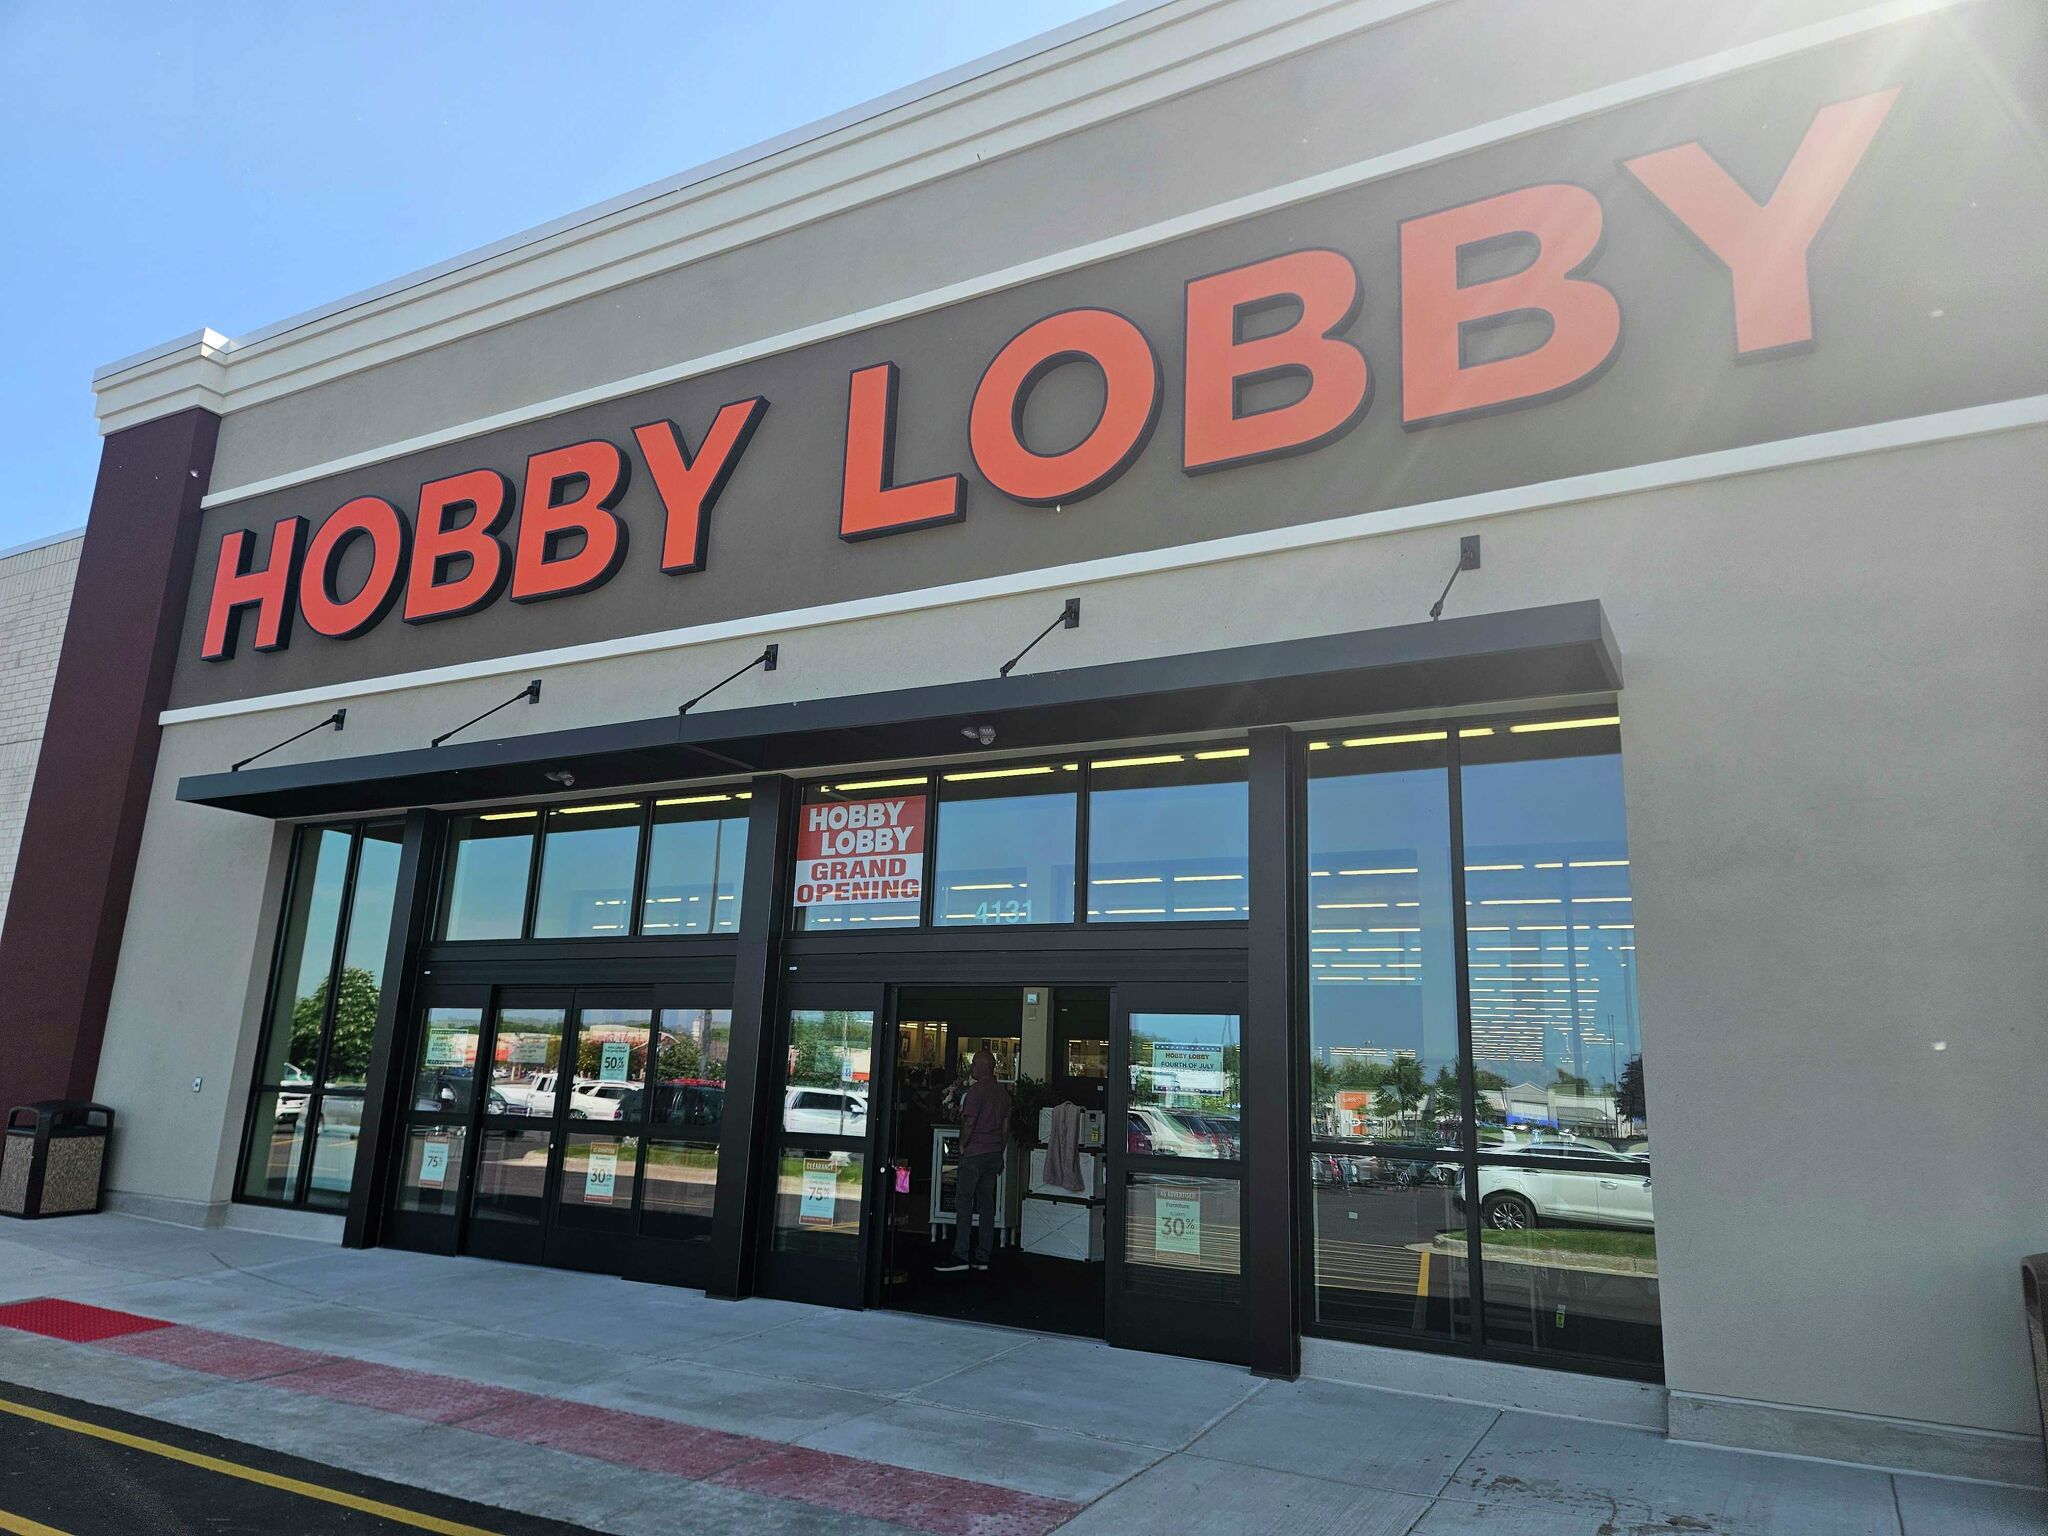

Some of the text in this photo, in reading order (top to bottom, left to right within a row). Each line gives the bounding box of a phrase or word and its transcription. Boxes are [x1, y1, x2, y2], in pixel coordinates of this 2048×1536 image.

[200, 85, 1904, 662] HOBBY LOBBY
[809, 801, 905, 831] HOBBY
[821, 826, 914, 856] LOBBY
[811, 858, 907, 881] GRAND
[797, 879, 919, 903] OPENING
[975, 900, 1031, 923] 4131
